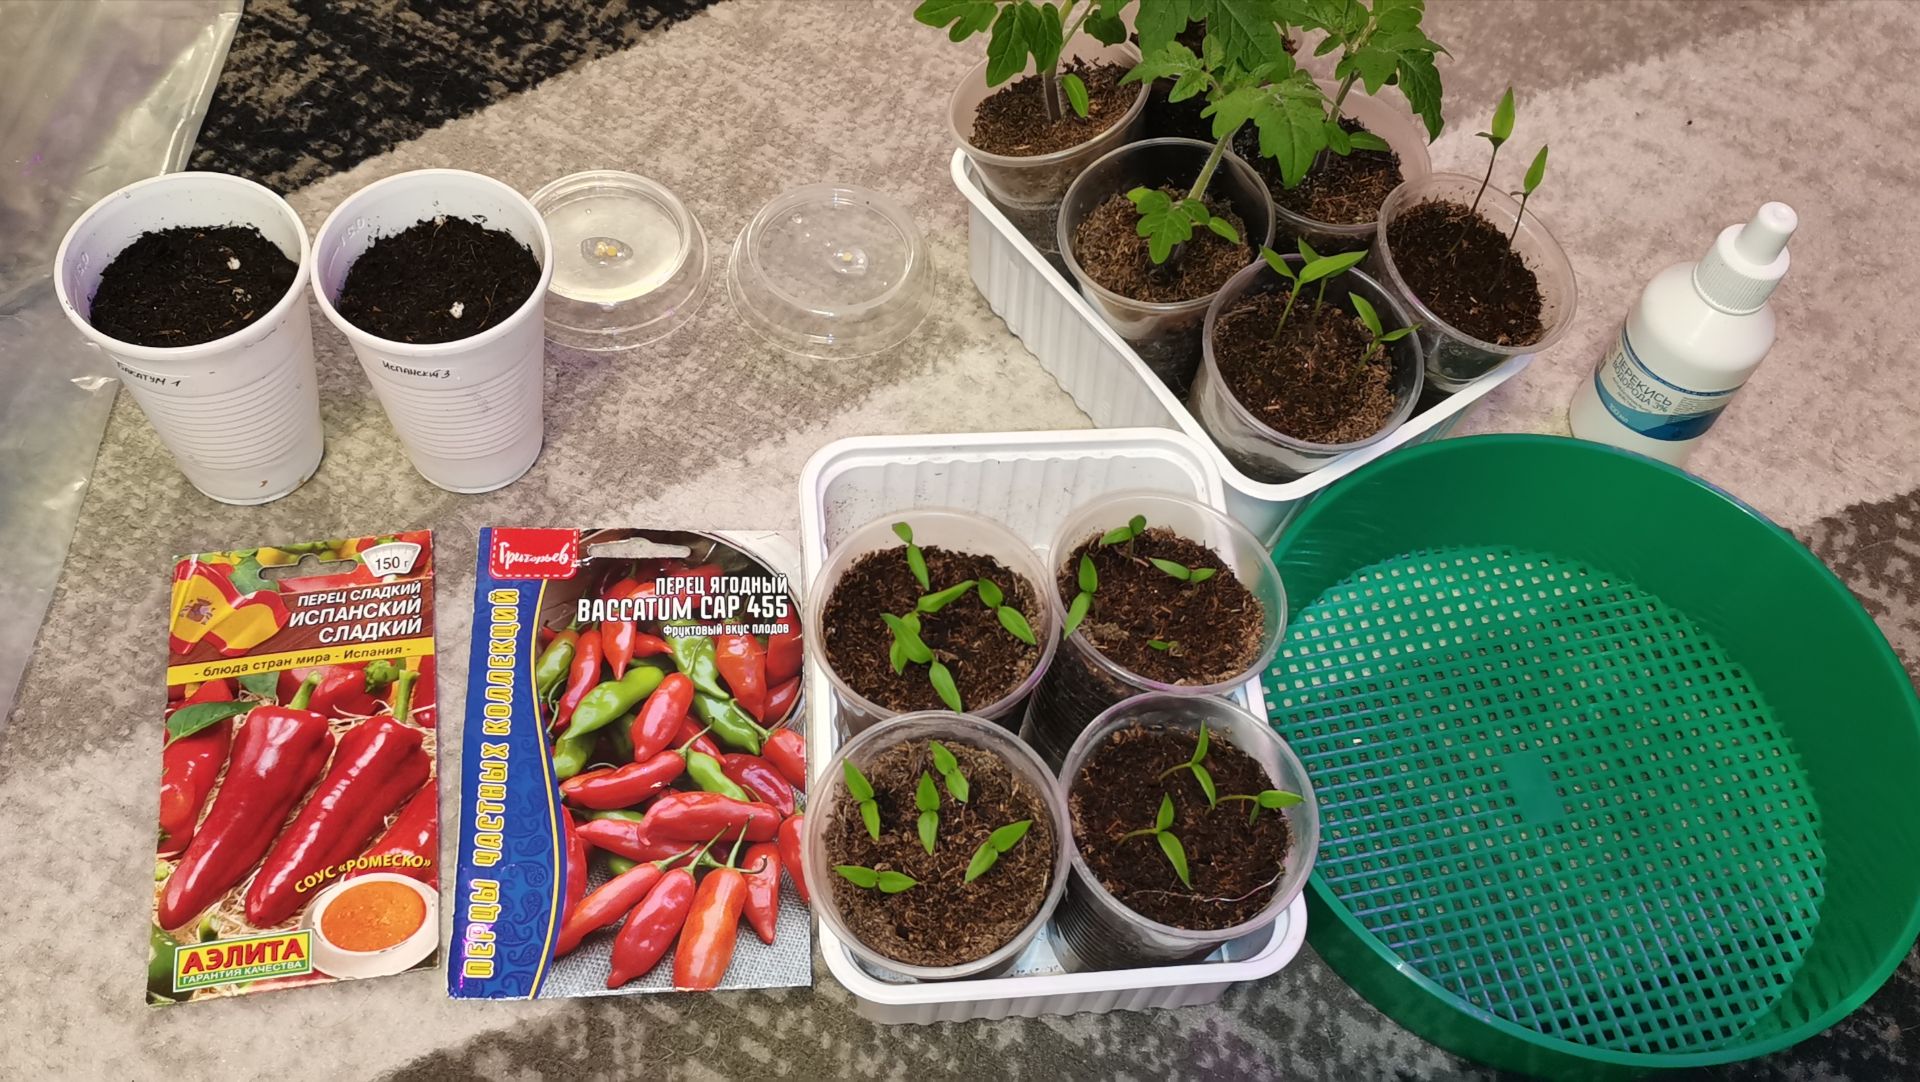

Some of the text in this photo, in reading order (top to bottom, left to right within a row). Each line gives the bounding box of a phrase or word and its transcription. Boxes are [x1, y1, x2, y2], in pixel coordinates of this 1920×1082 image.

[1613, 360, 1651, 406] ВОДОРОДА
[1616, 352, 1672, 406] ПЕРЕКИСЬ
[375, 556, 400, 571] 150
[298, 580, 422, 607] ПЕРЕЦ СЛАДКИЙ
[655, 573, 789, 596] ПЕРЕЦ ЯГОДНЫЙ
[289, 597, 422, 628] ИСПАНСКИЙ
[577, 595, 789, 623] BACCATUM CAP 455
[318, 616, 422, 644] СЛАДКИЙ
[663, 623, 789, 637] Фруктовый вкус плодов
[203, 662, 248, 678] блюда
[253, 658, 291, 670] стран
[296, 653, 331, 668] мира
[344, 646, 403, 660] Испания
[464, 589, 520, 978] ПЕРЦЫ ЧАСТНЫХ КОЛЛЕКЦИЙ
[294, 854, 431, 893] СОУС «РОМЕСКО»
[182, 938, 304, 974] АЭЛИТА
[182, 960, 302, 985] ГАРАНТИЯ КАЧЕСТВА
